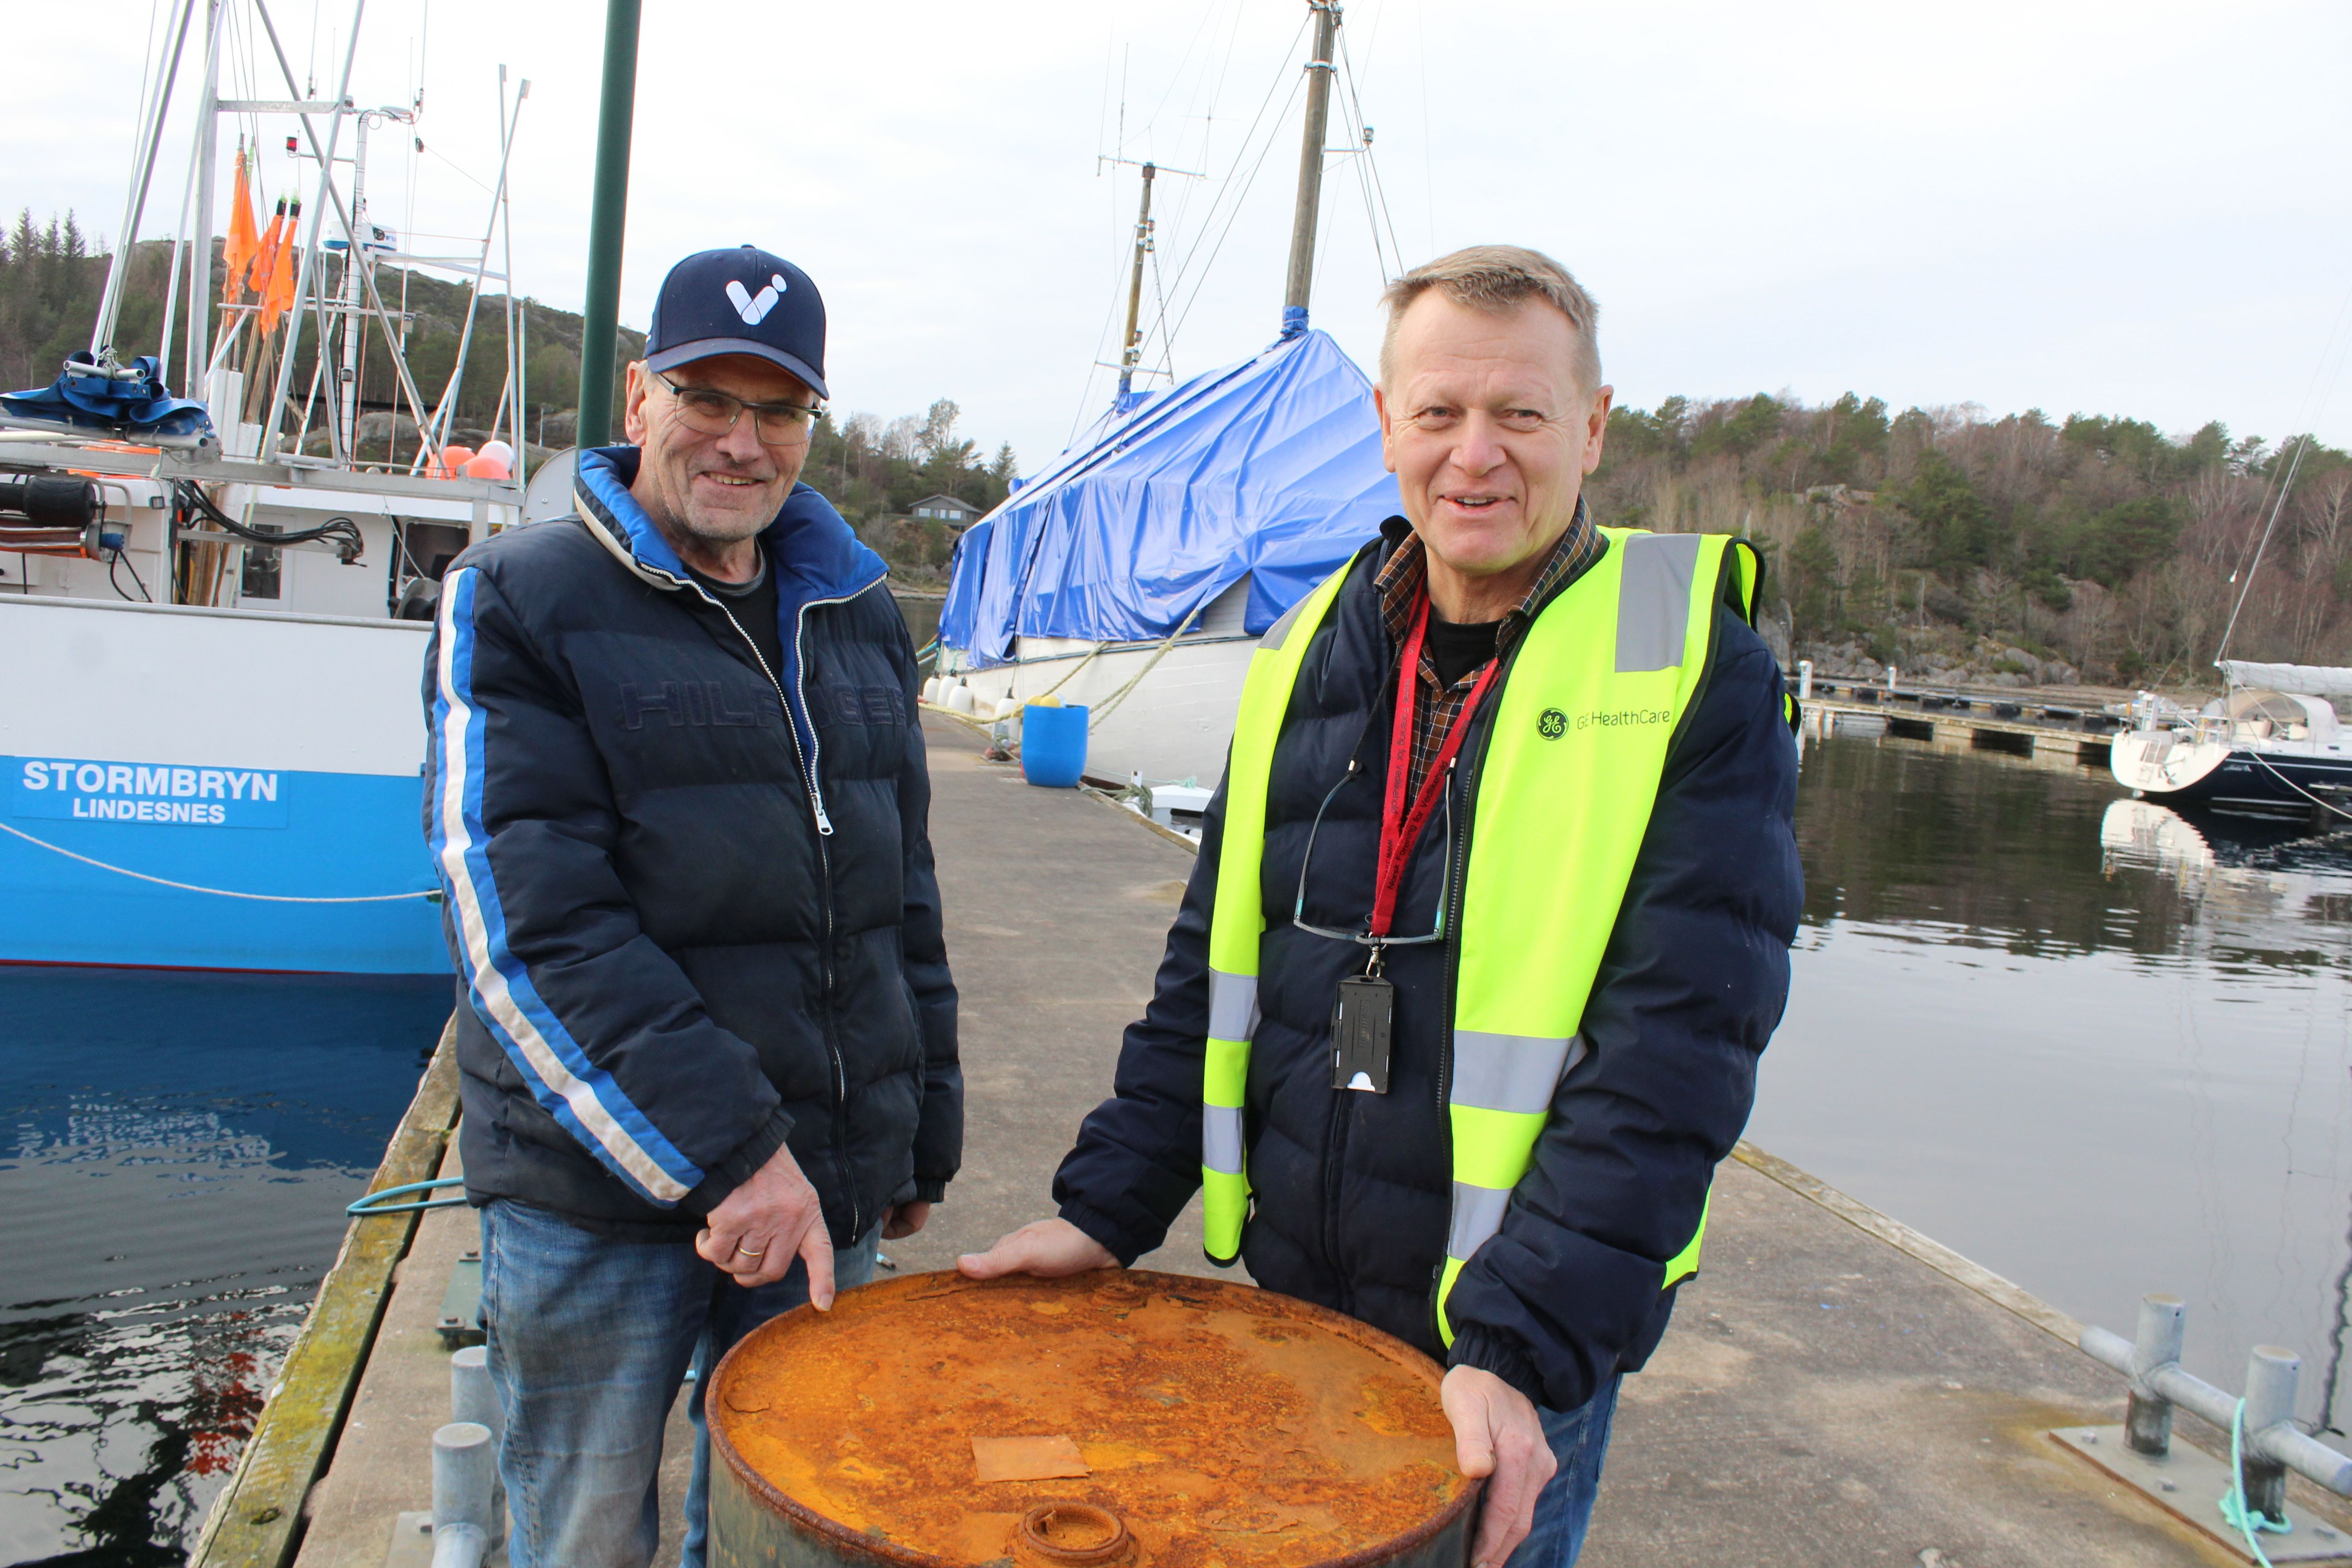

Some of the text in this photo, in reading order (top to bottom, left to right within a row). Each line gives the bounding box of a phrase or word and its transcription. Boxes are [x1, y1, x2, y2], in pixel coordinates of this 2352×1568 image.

[1577, 709, 1670, 730] GE HealthCare
[1390, 678, 1412, 814] Norsk Forening for Vedlikehold
[23, 761, 278, 801] STORMBRYN
[73, 798, 225, 824] LINDESNES
[1387, 864, 1400, 890] Norsk
[1396, 825, 1417, 861] Forening
[1413, 811, 1424, 823] for
[1420, 760, 1448, 808] Vedlikehold
